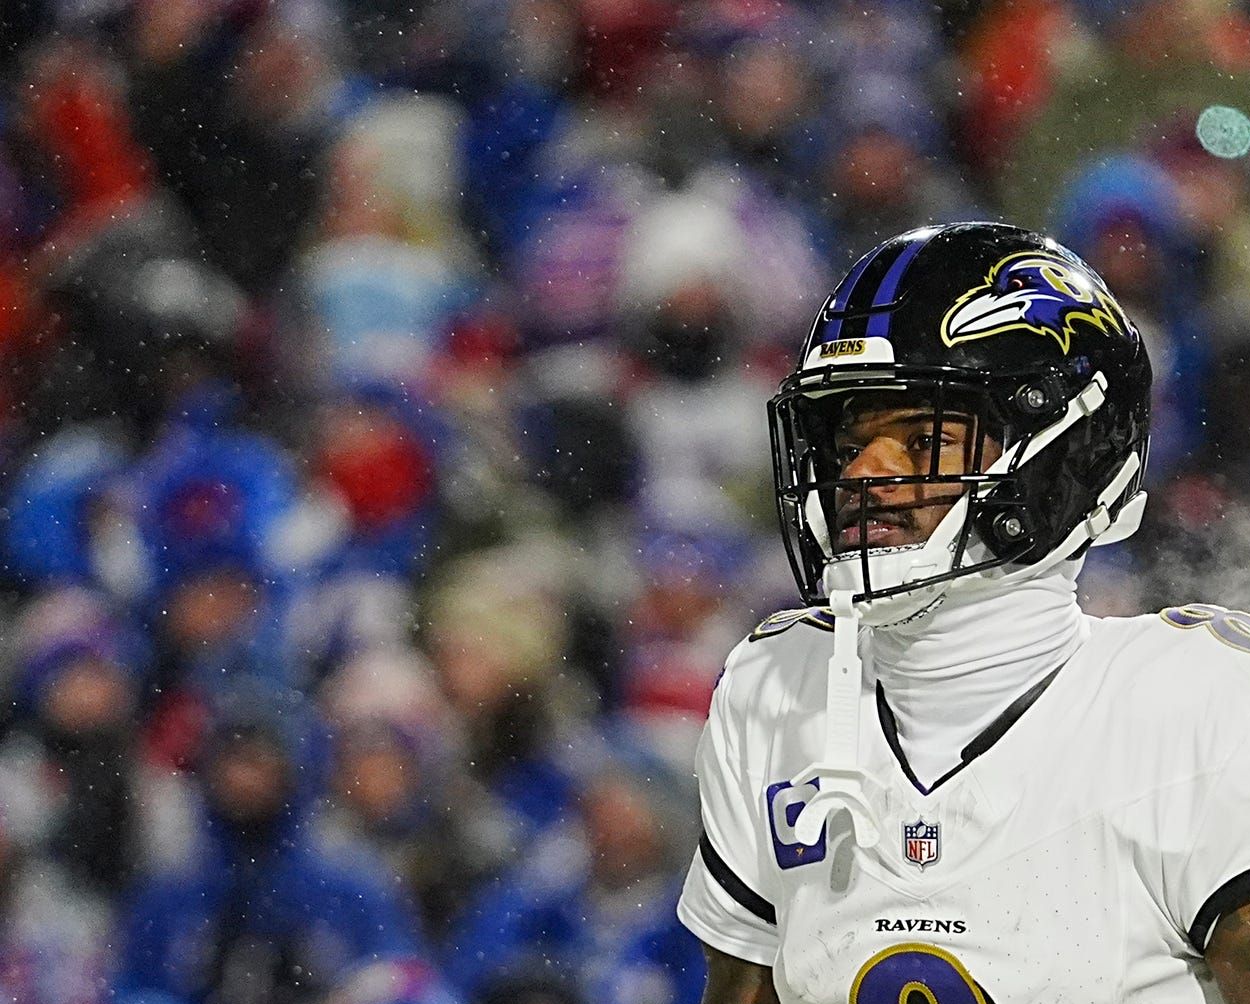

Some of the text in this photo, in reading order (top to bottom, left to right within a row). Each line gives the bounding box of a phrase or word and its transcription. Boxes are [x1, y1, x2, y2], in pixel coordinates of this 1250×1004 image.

[820, 340, 866, 358] RAVENS
[908, 839, 936, 861] NFL
[875, 918, 967, 934] RAVENS
